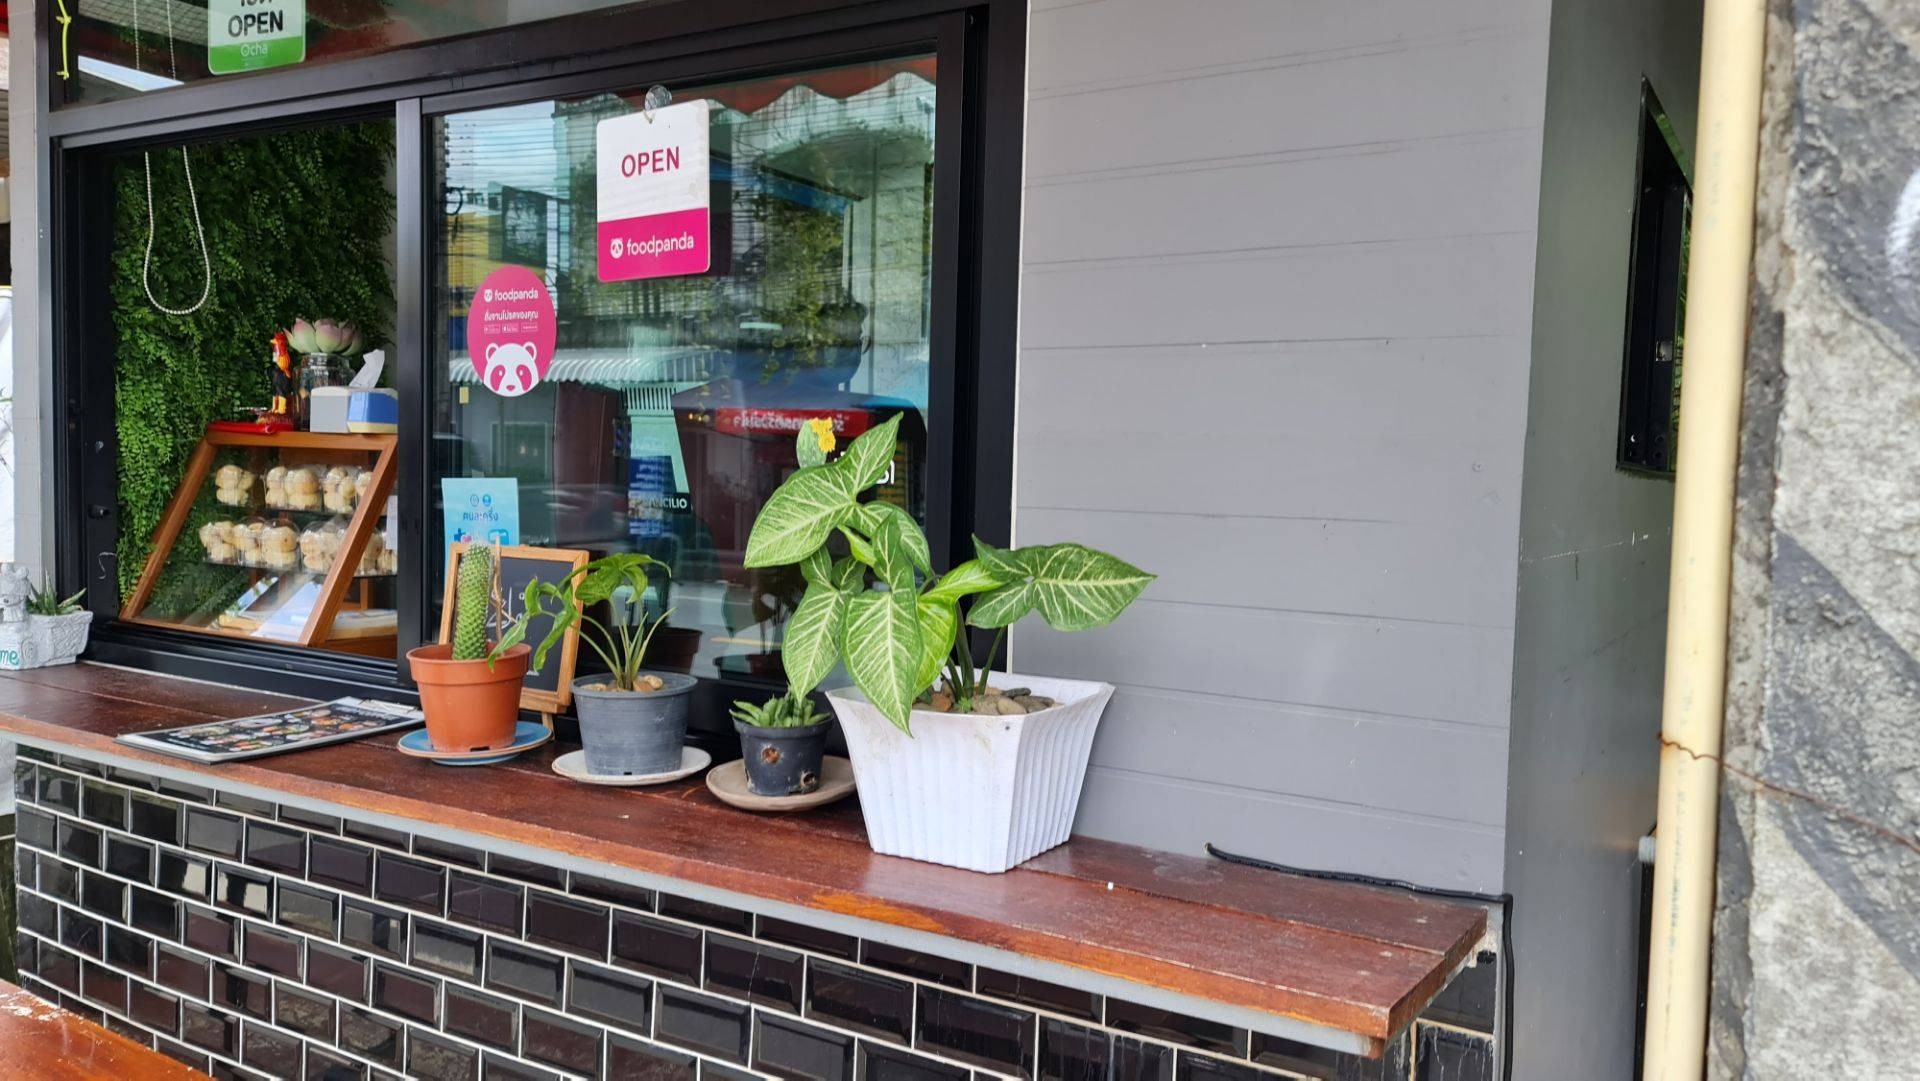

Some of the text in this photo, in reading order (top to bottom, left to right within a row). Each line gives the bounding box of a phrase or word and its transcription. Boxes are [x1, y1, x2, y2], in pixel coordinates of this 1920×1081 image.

[228, 10, 283, 37] OPEN
[240, 42, 268, 57] Ocha
[621, 146, 680, 178] OPEN
[626, 231, 694, 257] foodpanda
[494, 287, 539, 302] foodpanda
